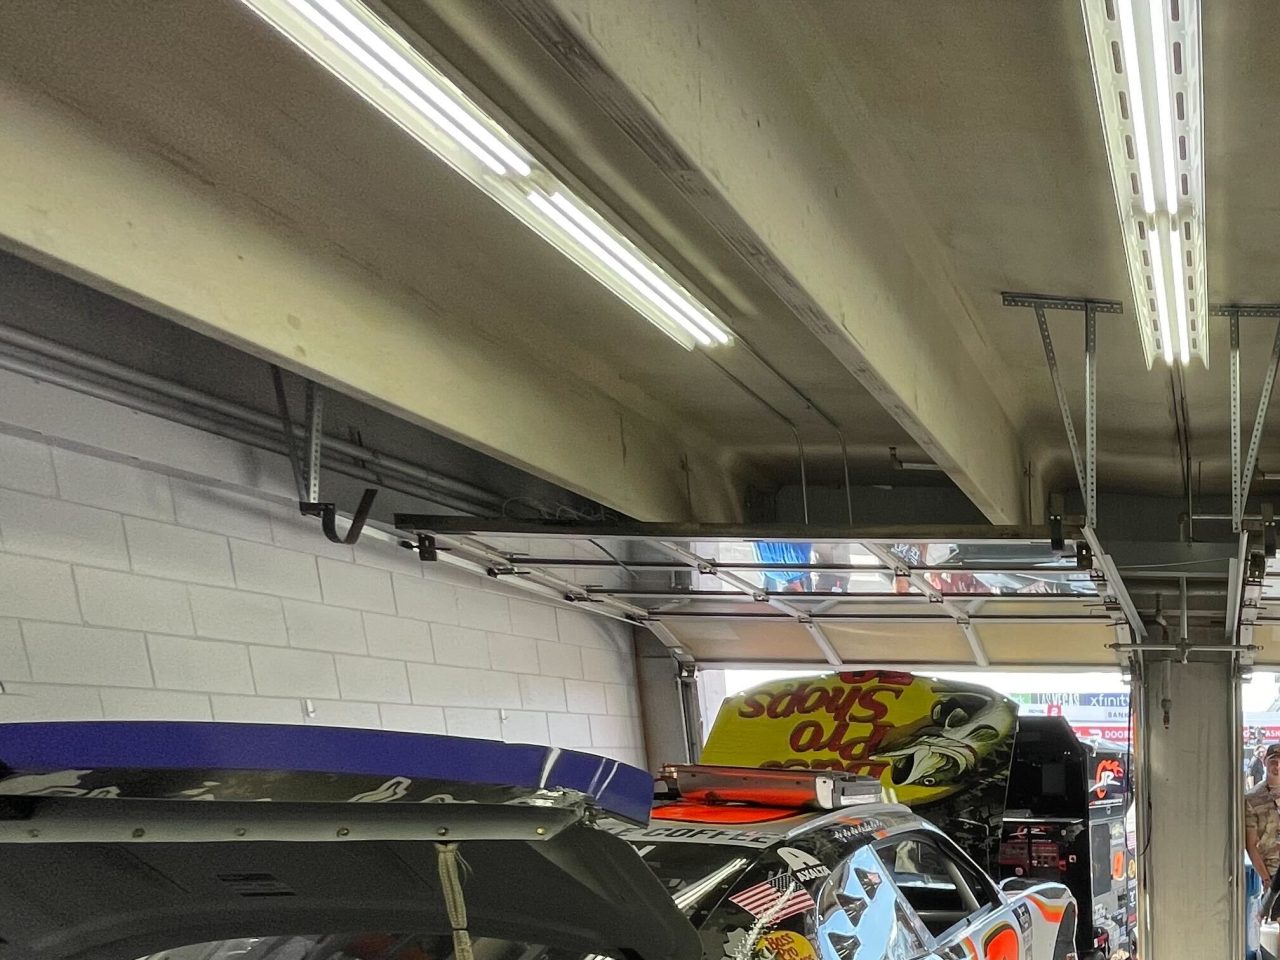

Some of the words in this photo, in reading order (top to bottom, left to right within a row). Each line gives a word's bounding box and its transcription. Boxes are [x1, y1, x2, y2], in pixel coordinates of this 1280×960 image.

[738, 682, 904, 723] Shops
[789, 720, 896, 761] Pro
[642, 827, 780, 844] COFFEE
[797, 865, 831, 882] AXALTA
[766, 933, 795, 951] Bass
